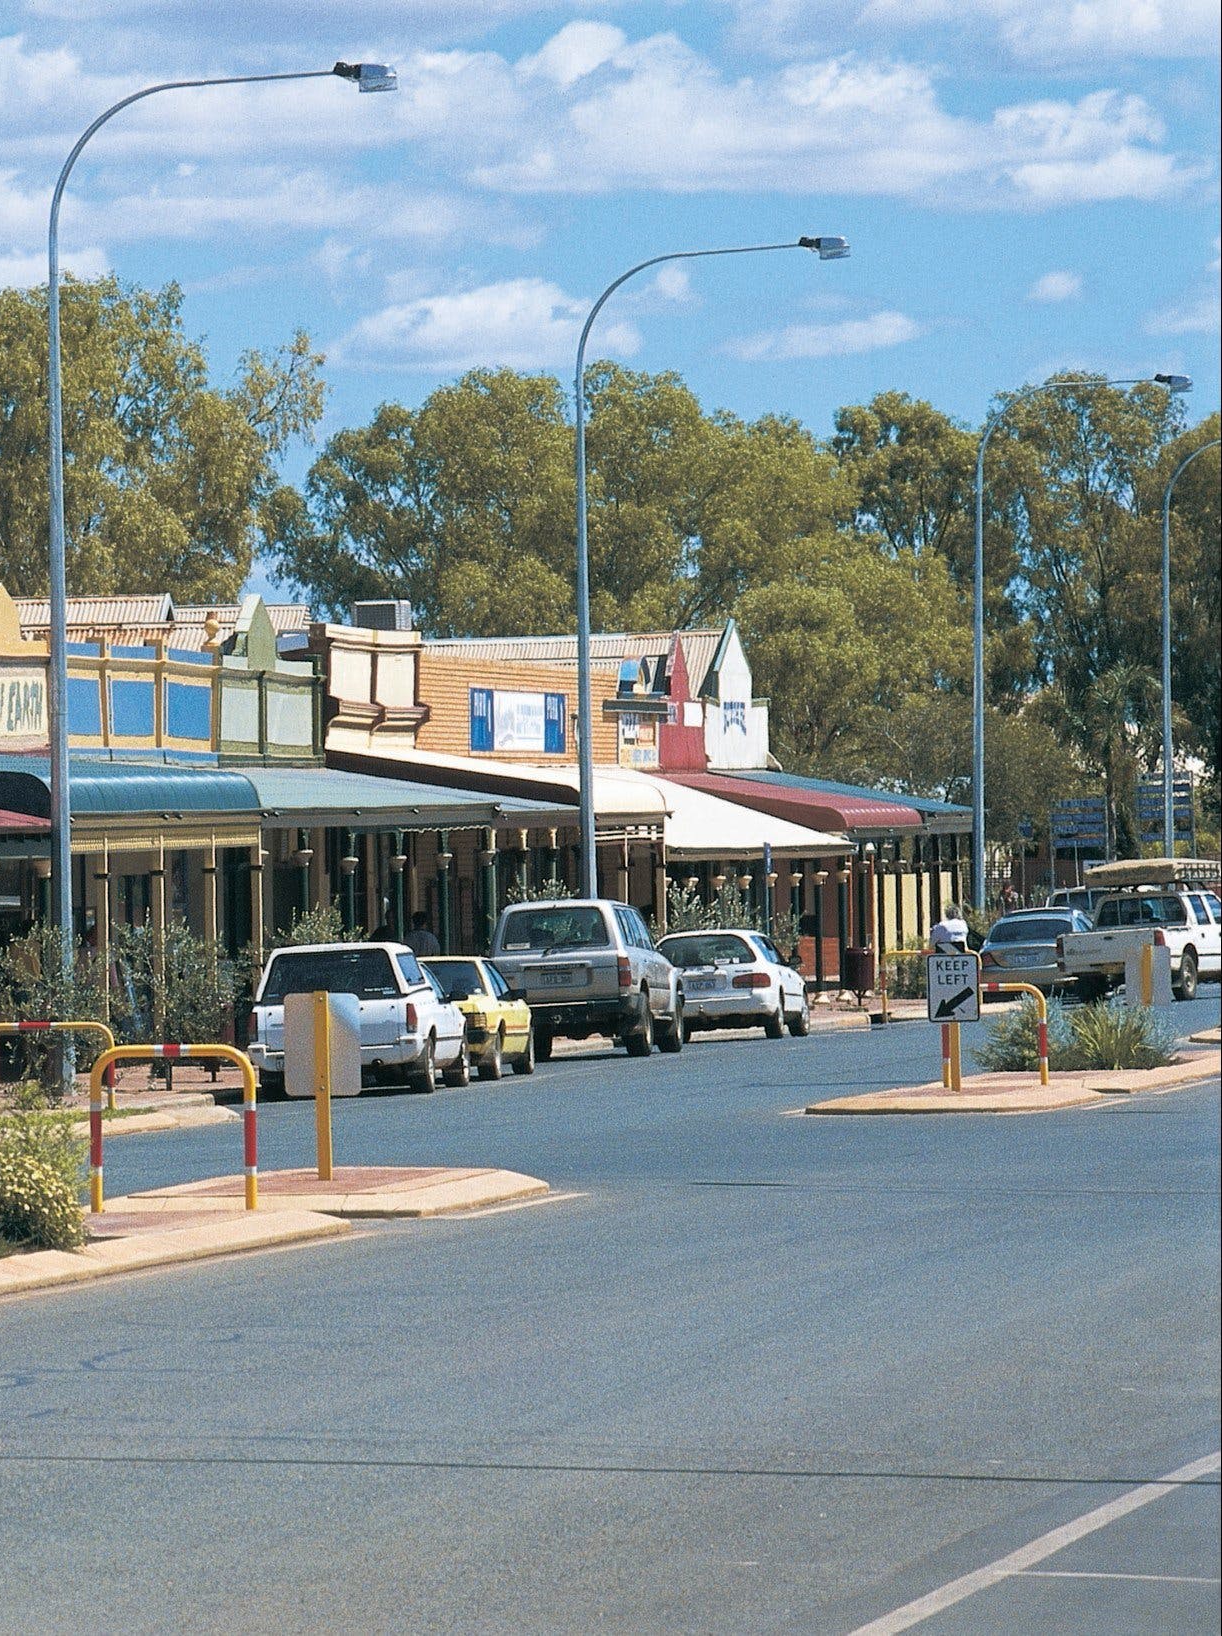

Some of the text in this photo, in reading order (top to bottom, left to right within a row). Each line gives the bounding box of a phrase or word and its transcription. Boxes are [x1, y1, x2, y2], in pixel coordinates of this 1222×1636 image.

[7, 680, 43, 731] EARTH
[936, 960, 969, 971] KEEP
[938, 974, 969, 985] LEFT
